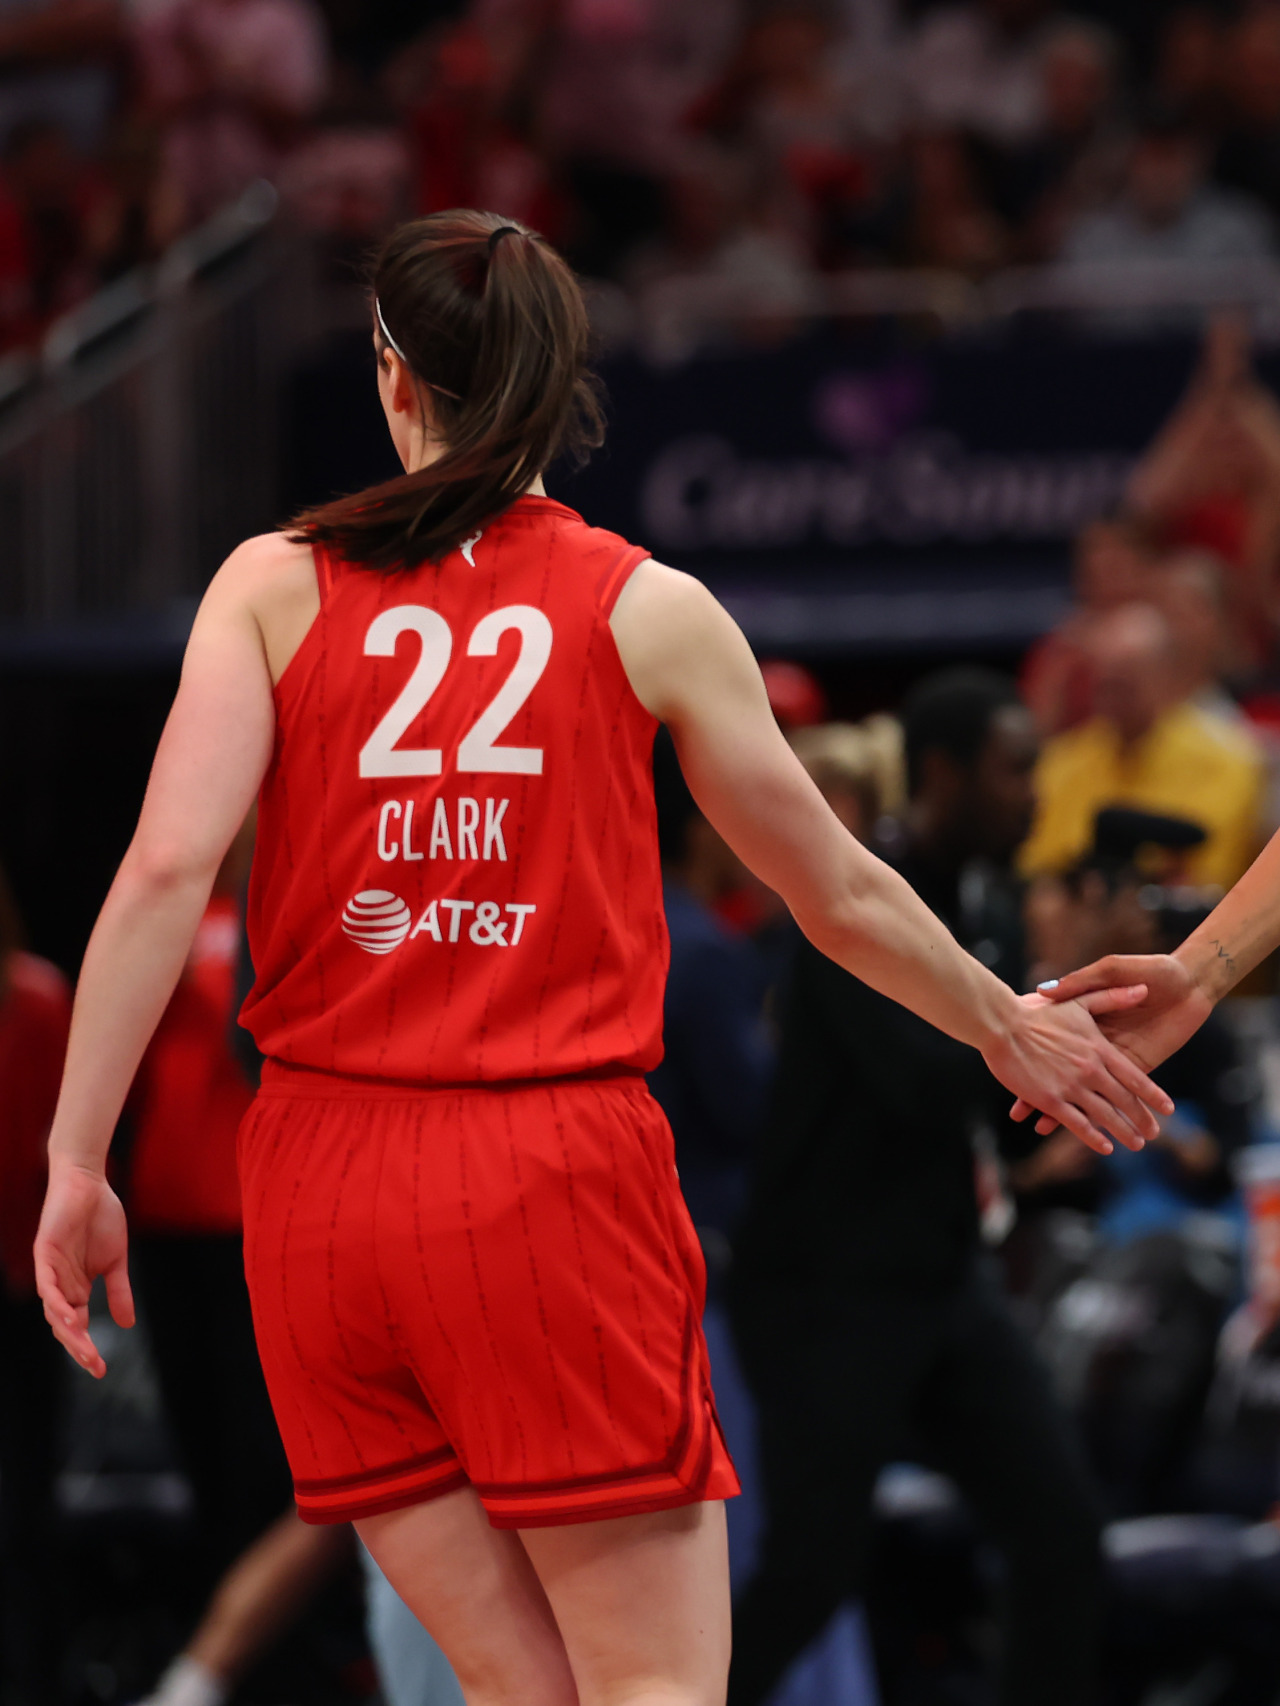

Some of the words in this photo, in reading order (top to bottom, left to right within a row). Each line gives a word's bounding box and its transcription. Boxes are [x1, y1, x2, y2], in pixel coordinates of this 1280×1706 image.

[359, 604, 554, 778] 22
[377, 797, 510, 862] CLARK
[409, 898, 537, 947] AT&T
